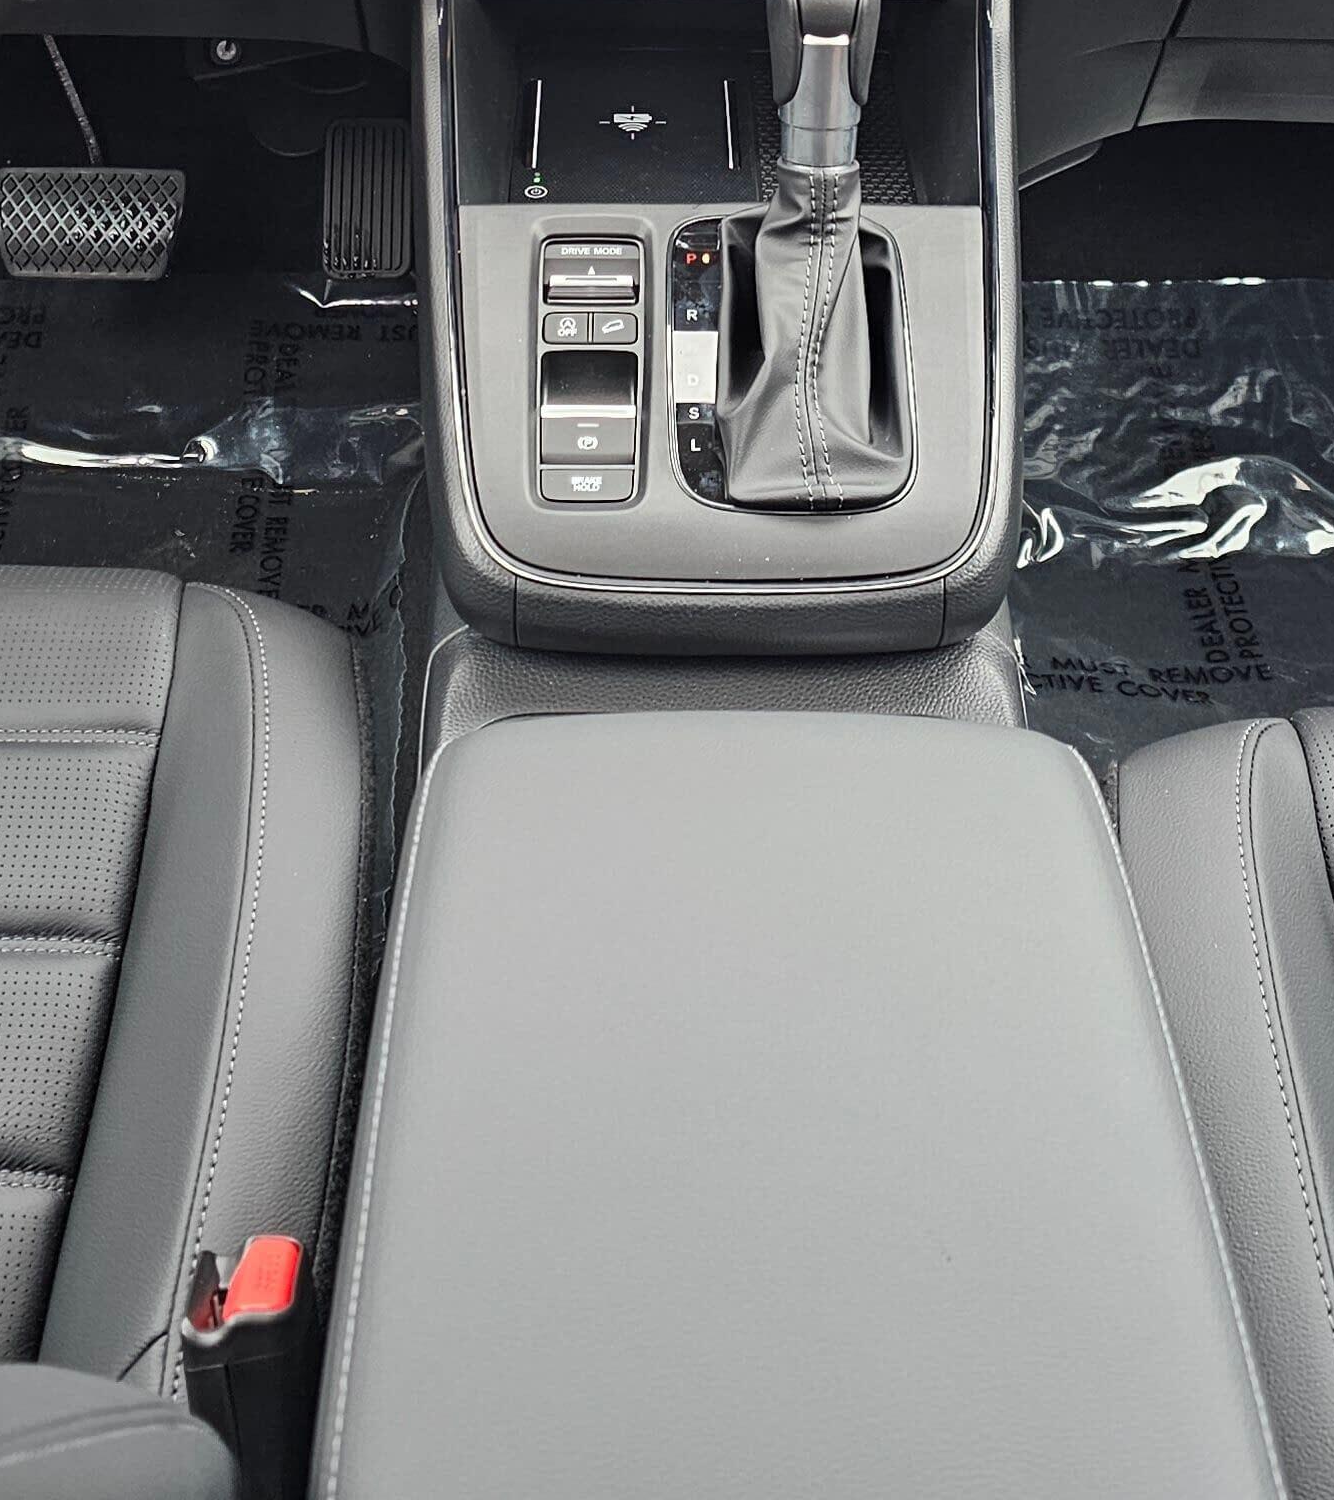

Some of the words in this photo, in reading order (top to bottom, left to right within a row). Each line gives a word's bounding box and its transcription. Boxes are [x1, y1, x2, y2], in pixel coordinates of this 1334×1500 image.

[560, 247, 590, 255] DRIVE
[593, 247, 623, 255] MODE
[686, 253, 697, 264] P
[686, 308, 698, 321] R
[557, 327, 578, 337] OFF
[687, 374, 700, 386] D
[688, 407, 700, 420] S
[690, 438, 701, 452] L
[571, 476, 602, 485] BRAKE
[573, 484, 601, 492] HOLD
[1185, 587, 1229, 664] DEALER
[1051, 656, 1132, 675] MUST
[1148, 662, 1273, 685] REMOVE
[1117, 679, 1212, 705] COVER
